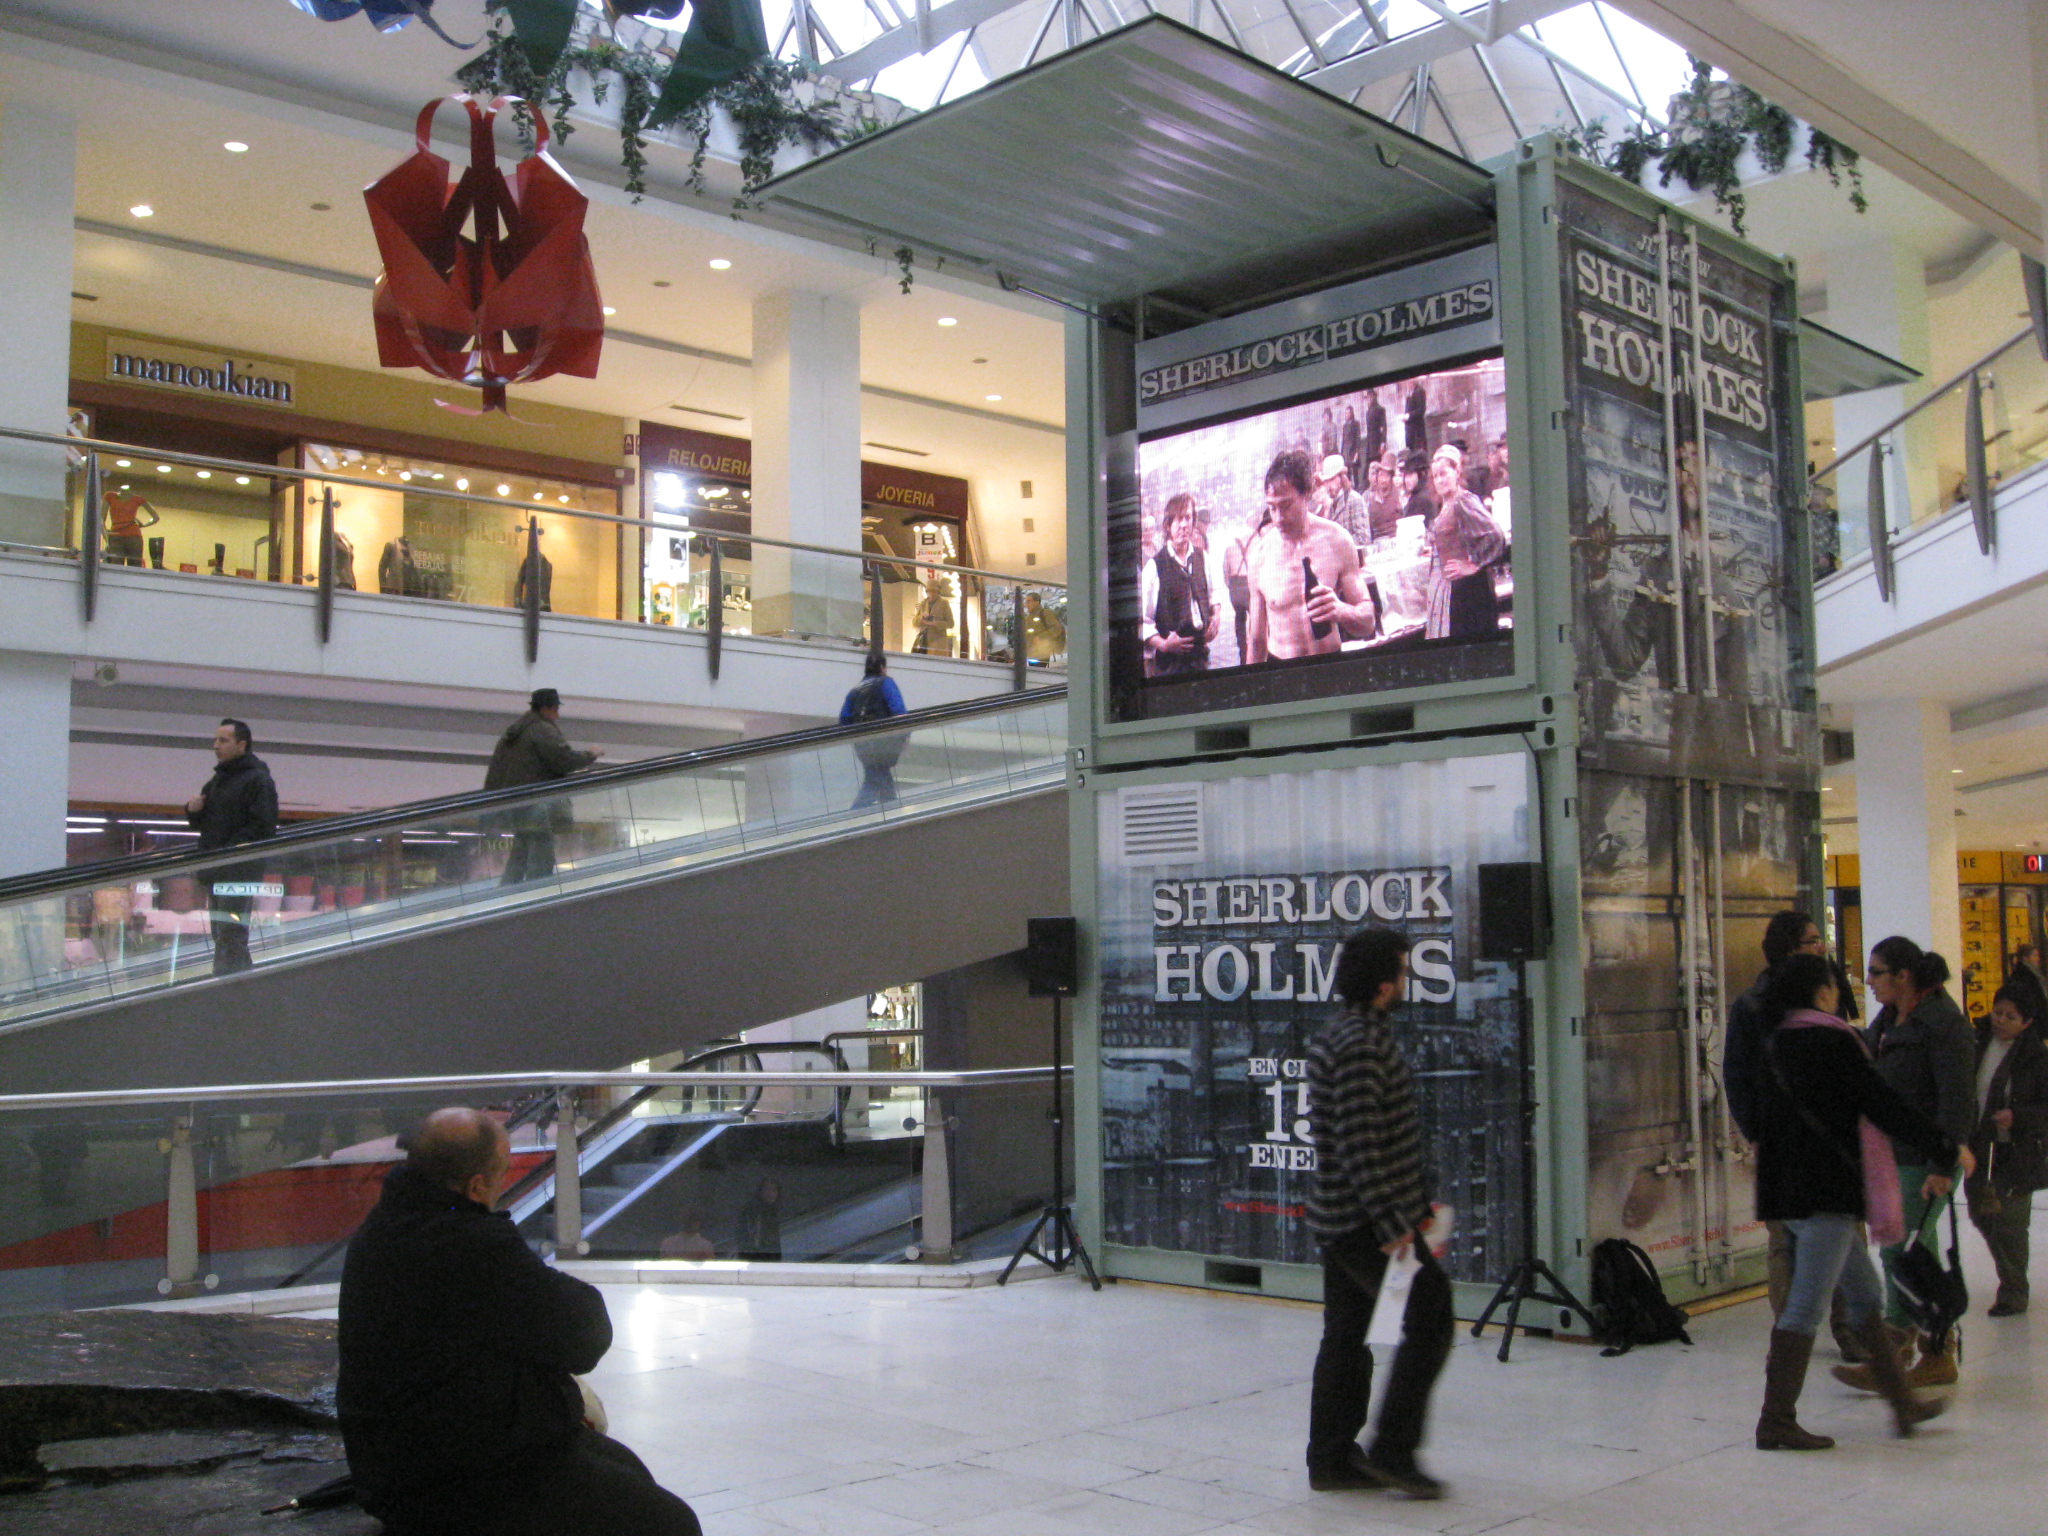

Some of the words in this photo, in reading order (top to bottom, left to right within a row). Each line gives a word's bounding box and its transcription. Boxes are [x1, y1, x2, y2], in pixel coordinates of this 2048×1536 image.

[1576, 250, 1762, 366] SHERLOCK
[1141, 326, 1324, 399] SHERLOCK
[1327, 281, 1493, 349] HOLMES
[113, 353, 291, 403] manoukian
[1578, 312, 1767, 431] HOLMES
[876, 485, 935, 508] JOYERIA
[1153, 870, 1453, 927] SHERLOCK
[1154, 939, 1457, 1003] HOLMS
[1248, 1058, 1278, 1076] EN
[1265, 1080, 1316, 1144] 15
[1249, 1144, 1317, 1171] ENE
